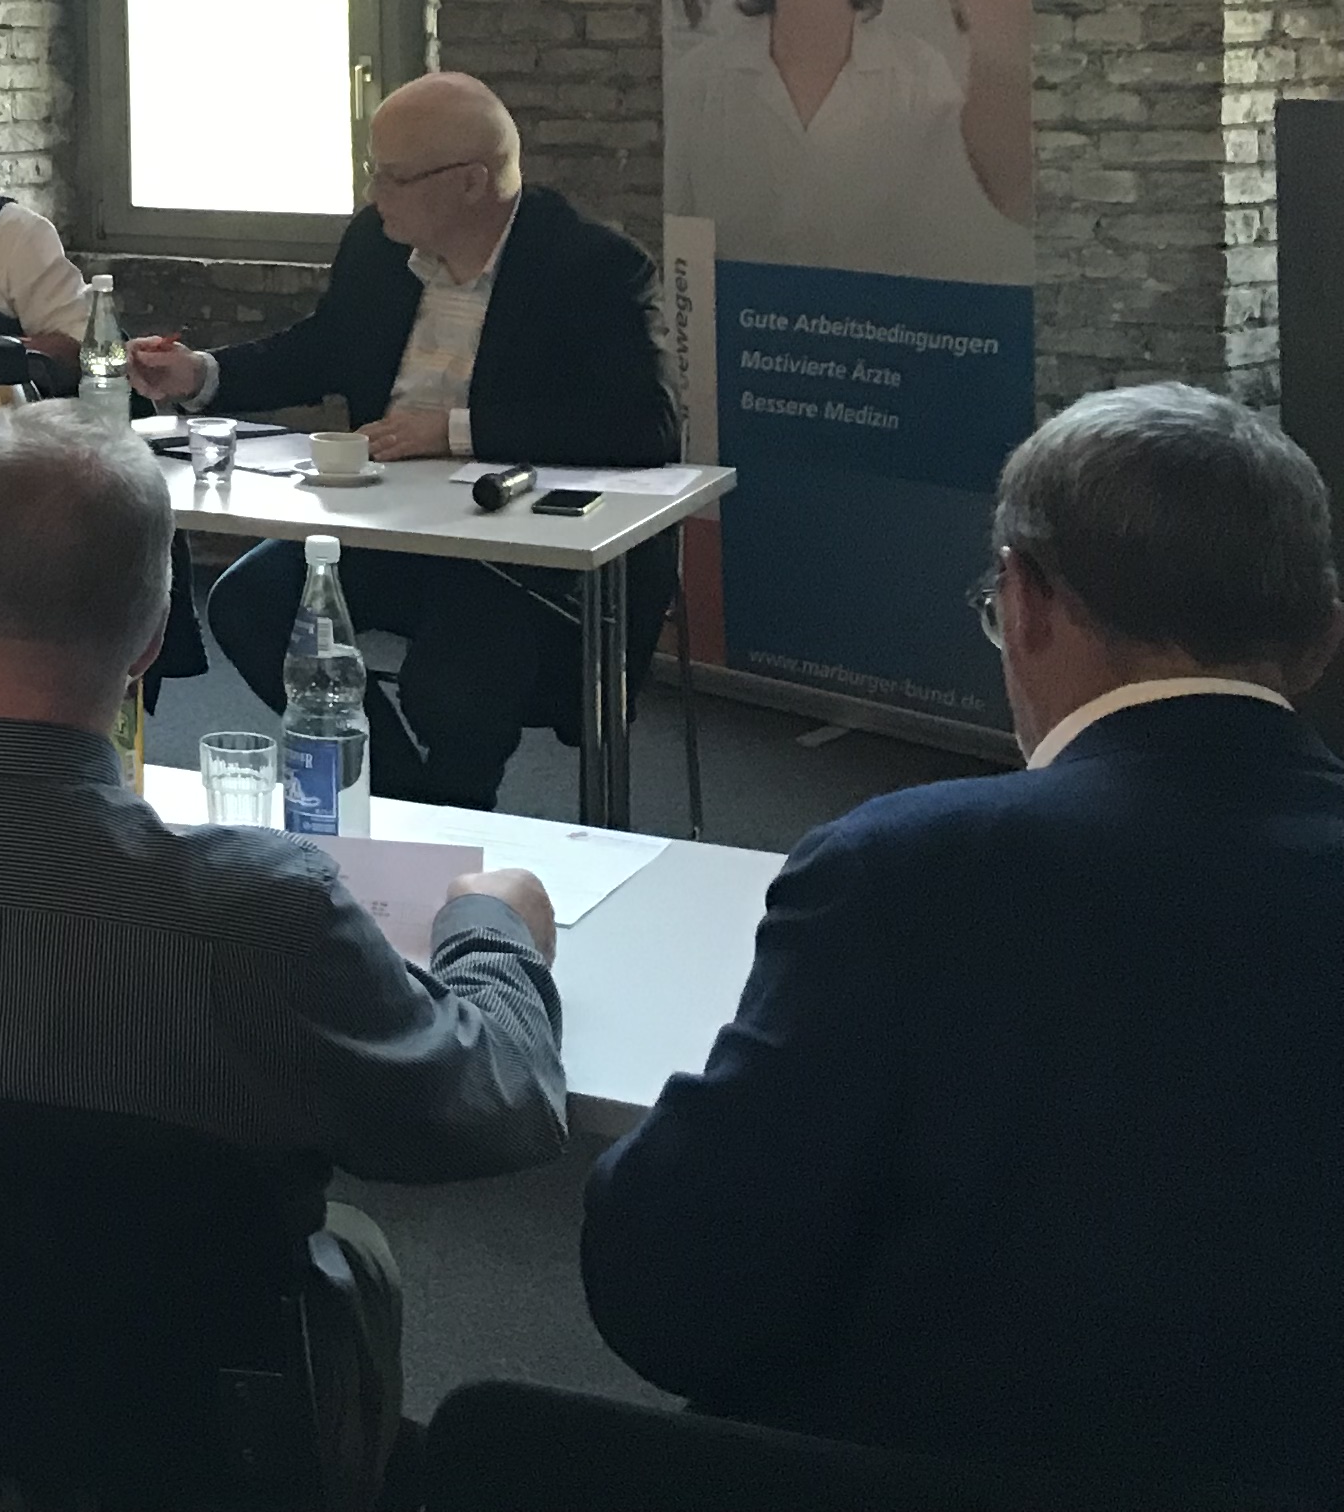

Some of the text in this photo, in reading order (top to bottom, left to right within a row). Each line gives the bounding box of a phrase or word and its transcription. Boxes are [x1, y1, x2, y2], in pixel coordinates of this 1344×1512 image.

[739, 308, 1000, 357] Gute Arbeitsbedingungen
[740, 350, 902, 387] Motivierte Ärzte
[740, 391, 900, 430] Bessere Medizin
